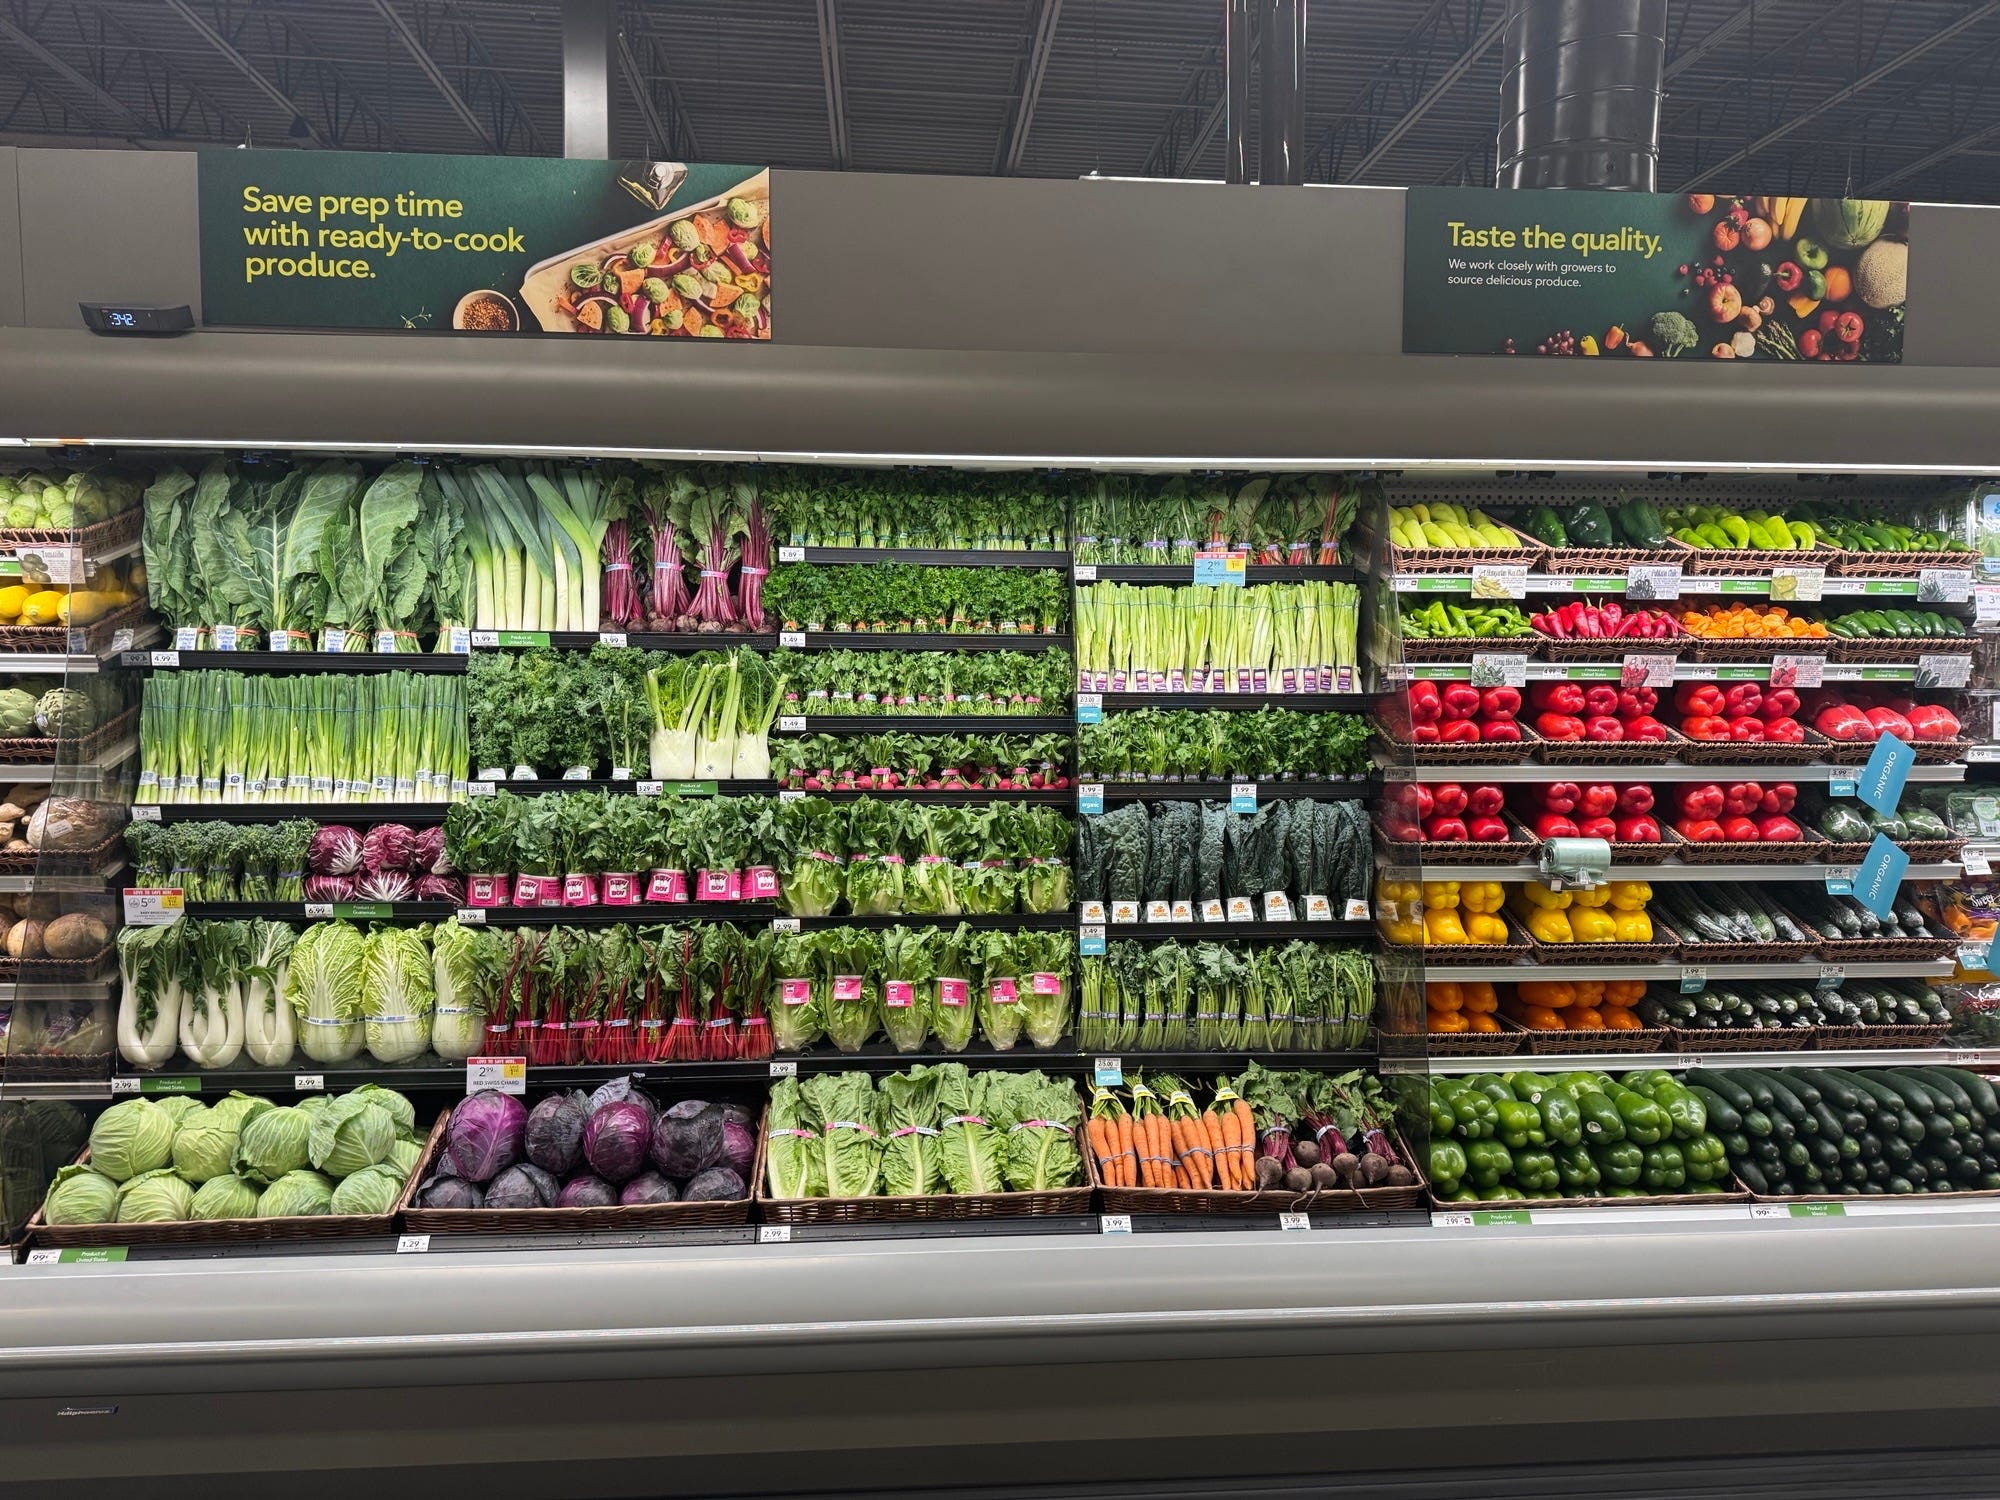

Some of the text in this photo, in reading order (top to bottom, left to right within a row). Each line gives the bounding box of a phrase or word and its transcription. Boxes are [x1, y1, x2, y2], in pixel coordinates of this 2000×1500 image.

[243, 186, 464, 223] Save prep time
[243, 220, 526, 256] with ready-to-cook
[1448, 222, 1662, 259] Taste the quality.
[245, 252, 376, 283] produce.
[1448, 258, 1616, 275] We work closely with growers to
[1448, 274, 1582, 289] source delicious produce.
[1874, 752, 1897, 799] ORGANIC
[1869, 854, 1890, 900] ORGANIC
